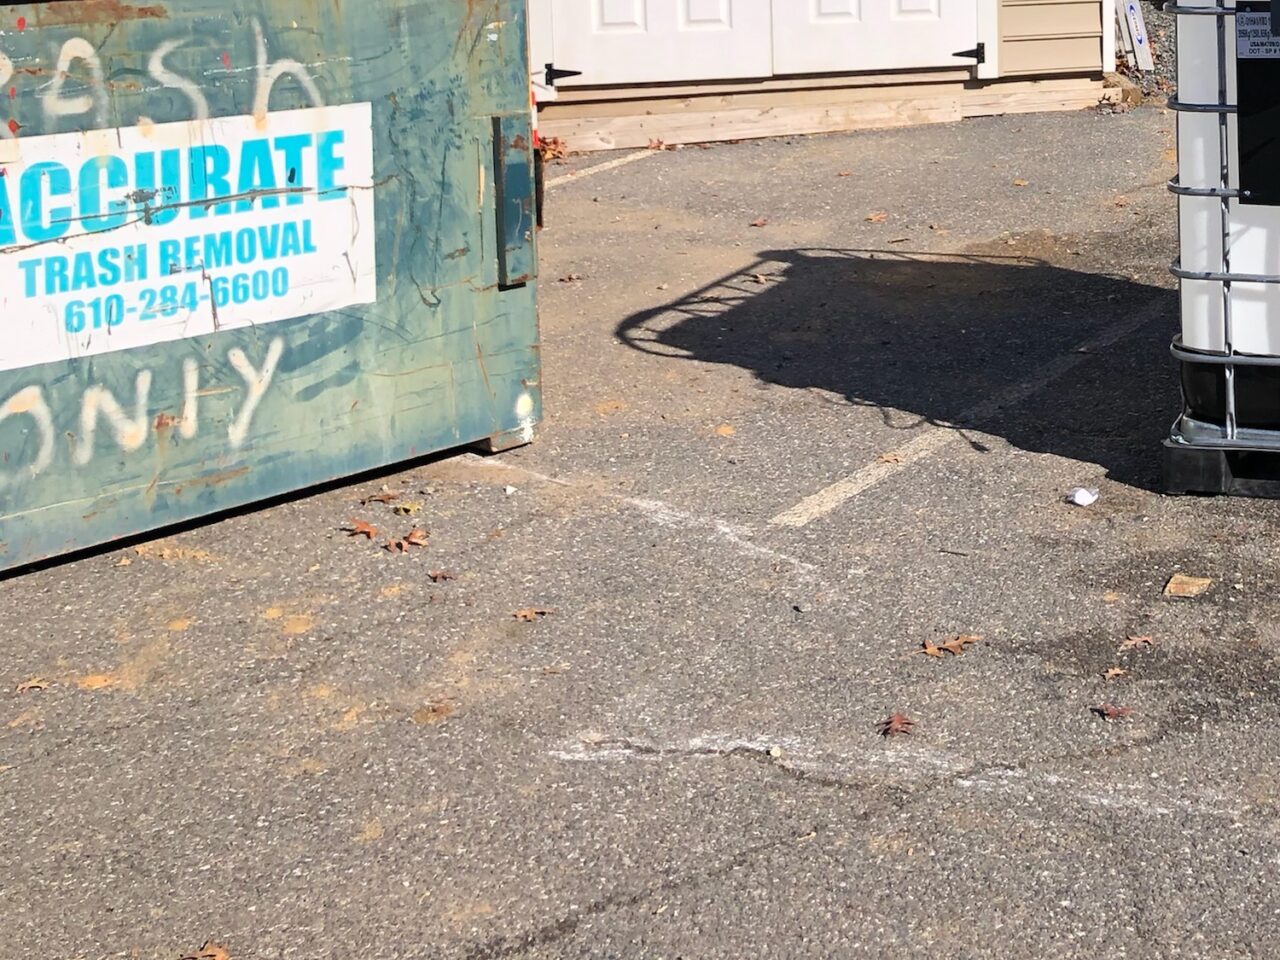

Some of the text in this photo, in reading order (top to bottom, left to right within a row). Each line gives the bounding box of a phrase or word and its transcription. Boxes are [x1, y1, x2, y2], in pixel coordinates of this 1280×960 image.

[18, 219, 317, 298] TRASH REMOVAL
[65, 267, 289, 333] 610-284-6600
